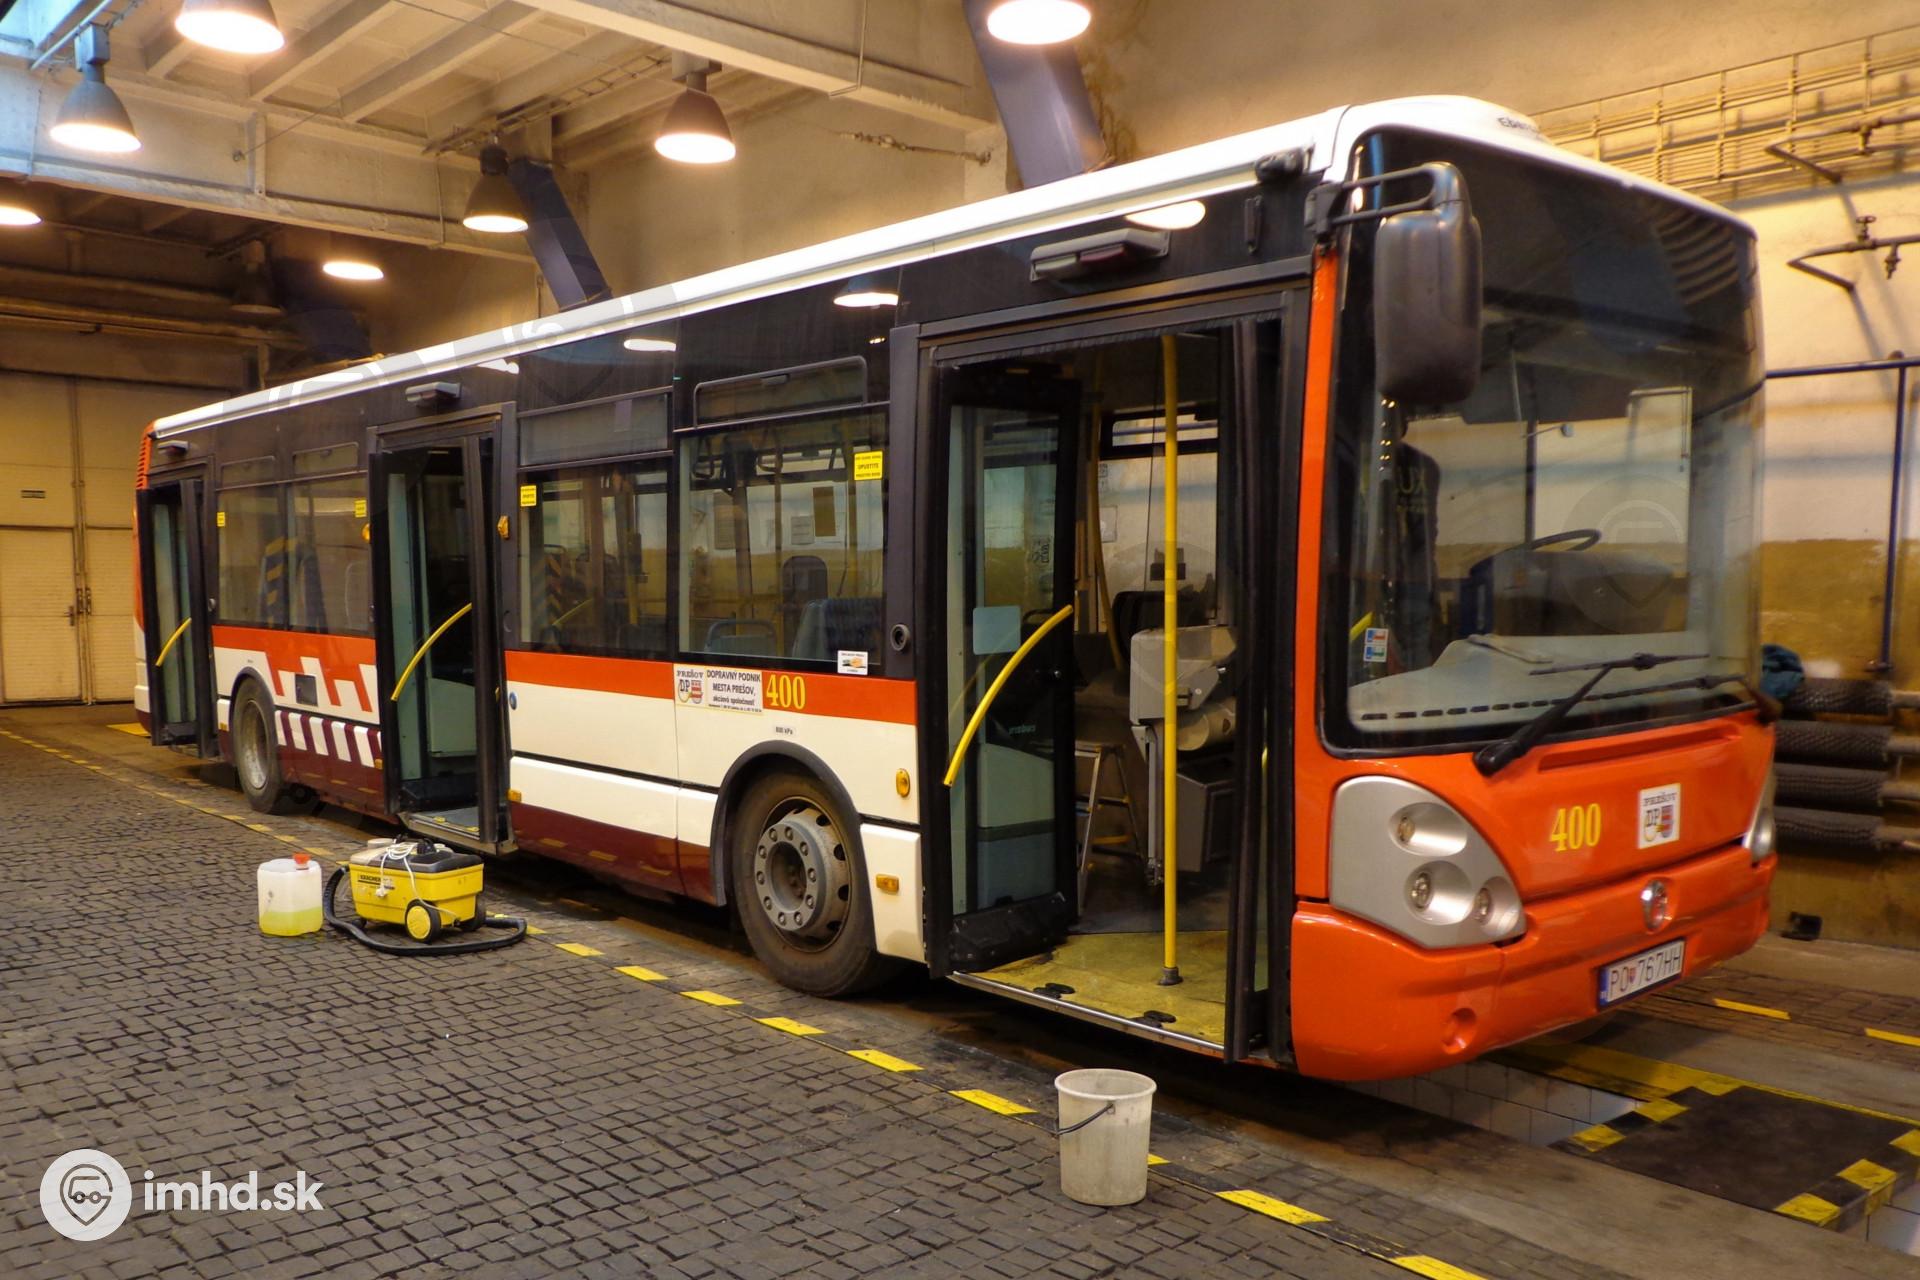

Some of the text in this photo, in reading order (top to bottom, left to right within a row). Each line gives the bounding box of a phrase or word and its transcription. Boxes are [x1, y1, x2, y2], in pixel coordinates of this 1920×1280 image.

[676, 669, 704, 679] PREŠOV
[706, 669, 761, 682] DOPRAVNÝ PODNIK
[680, 679, 691, 692] DP
[712, 683, 731, 692] MESTA
[766, 674, 806, 710] 400
[1646, 808, 1660, 827] DP
[1549, 803, 1601, 852] 400
